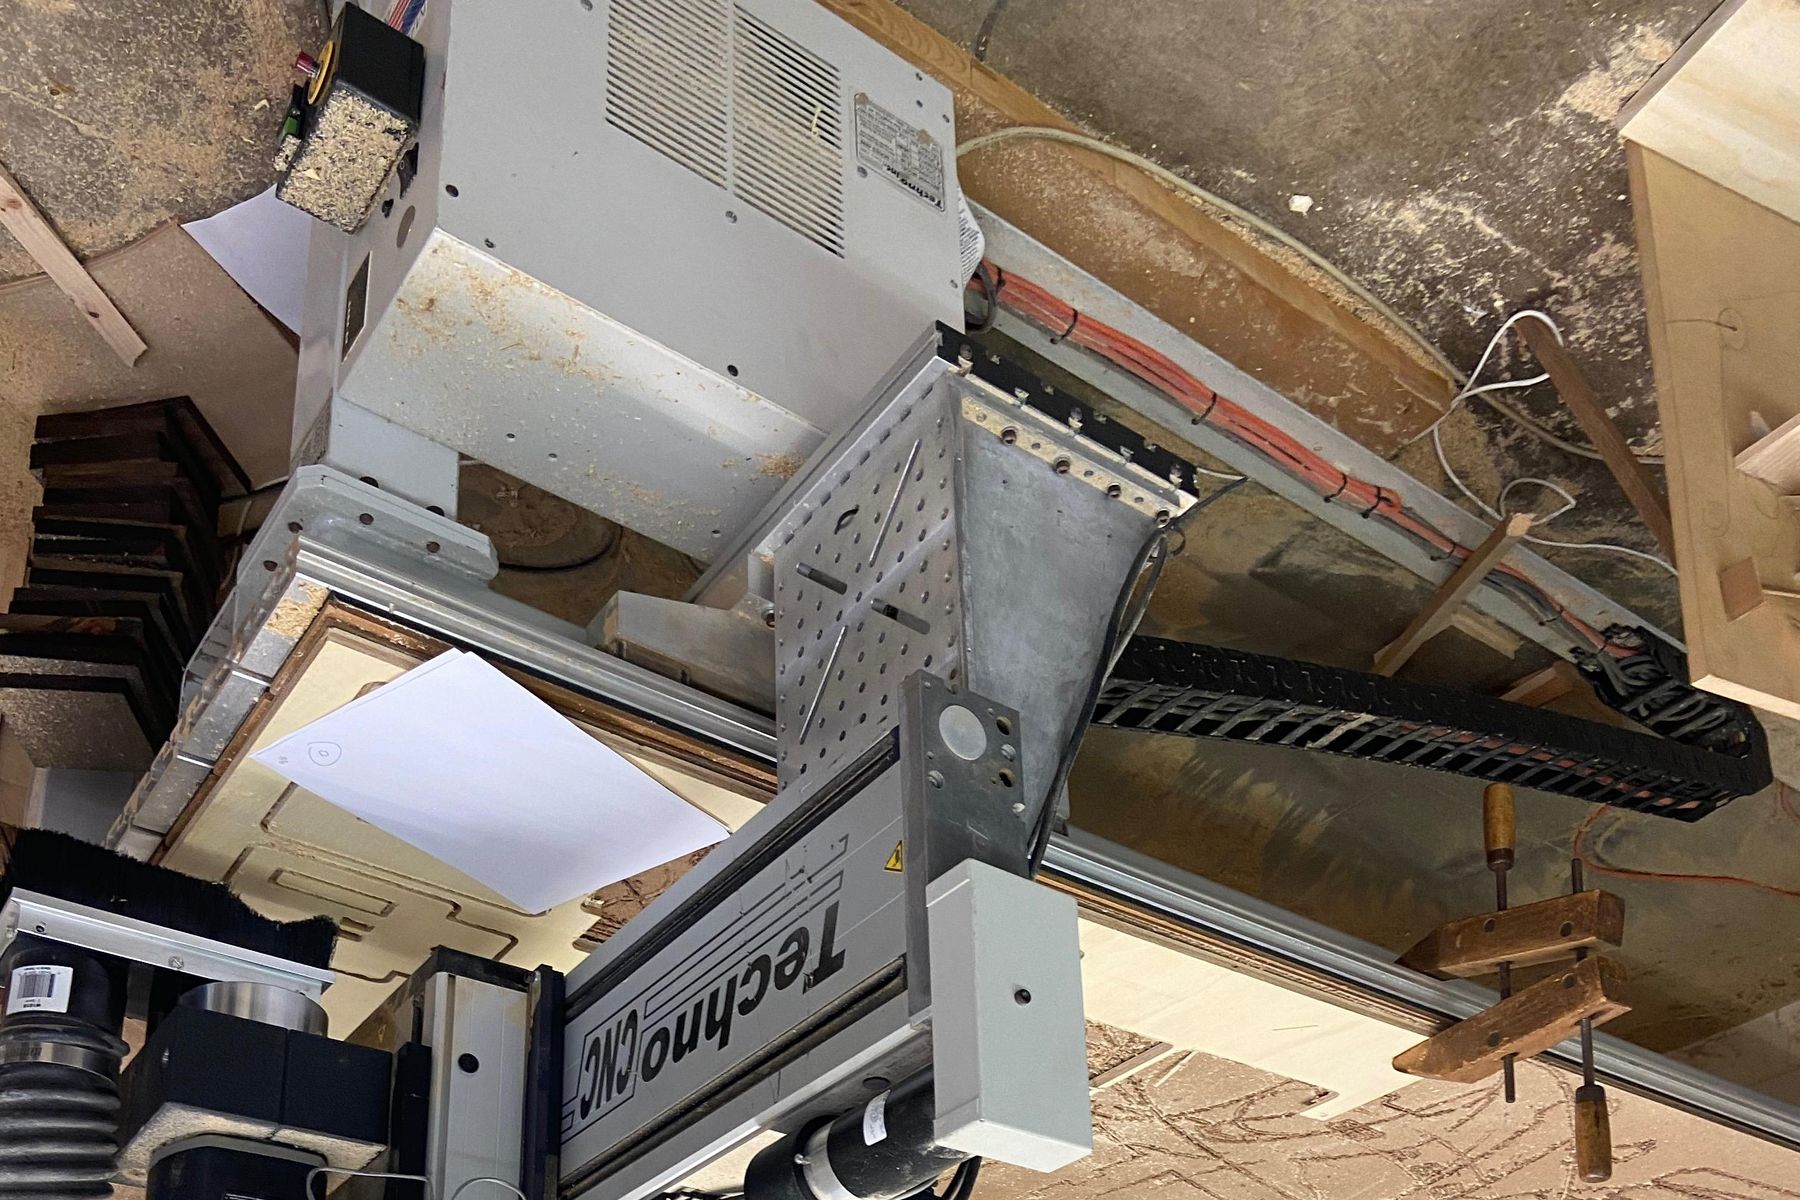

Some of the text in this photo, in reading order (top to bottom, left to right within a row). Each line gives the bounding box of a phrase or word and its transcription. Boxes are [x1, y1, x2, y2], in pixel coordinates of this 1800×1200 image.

[900, 178, 943, 210] Techno
[580, 901, 846, 1121] Techno CNC
